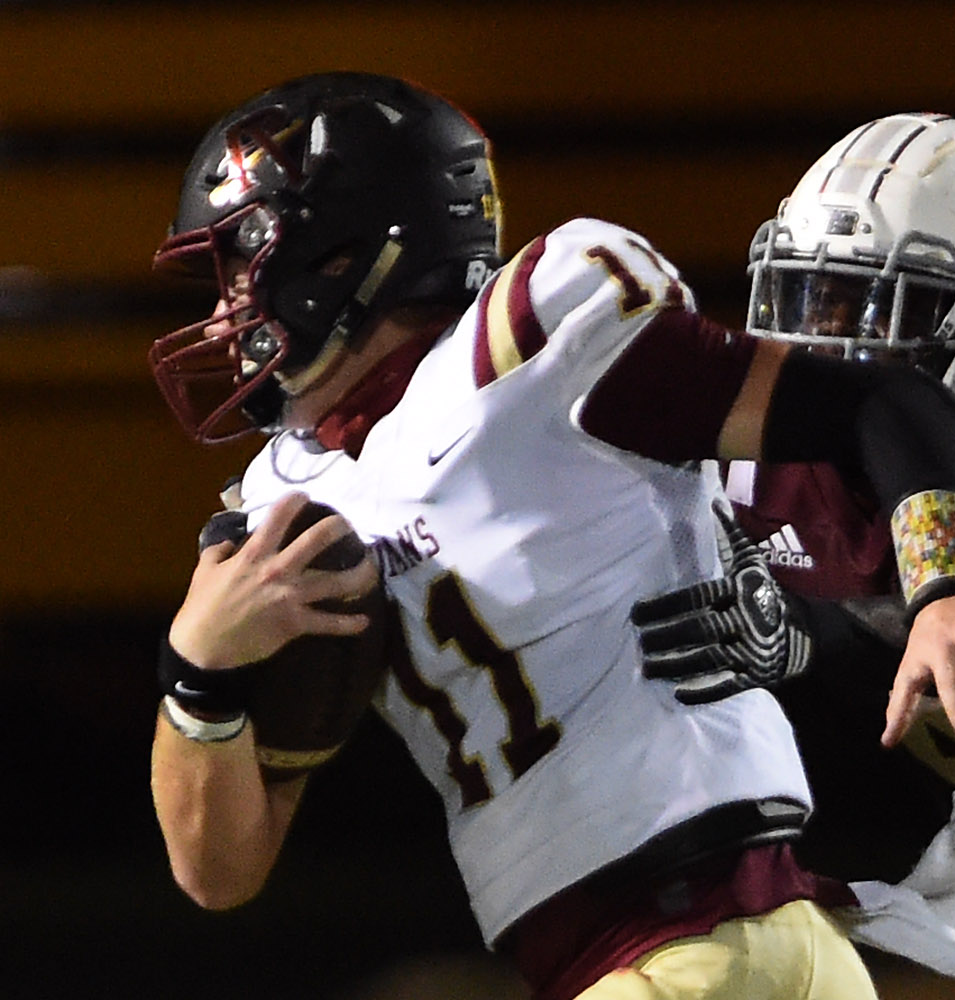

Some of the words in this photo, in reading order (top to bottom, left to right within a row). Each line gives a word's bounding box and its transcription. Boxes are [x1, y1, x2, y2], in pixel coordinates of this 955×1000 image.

[382, 515, 440, 578] ANS
[757, 548, 814, 569] didas
[388, 568, 563, 809] 11
